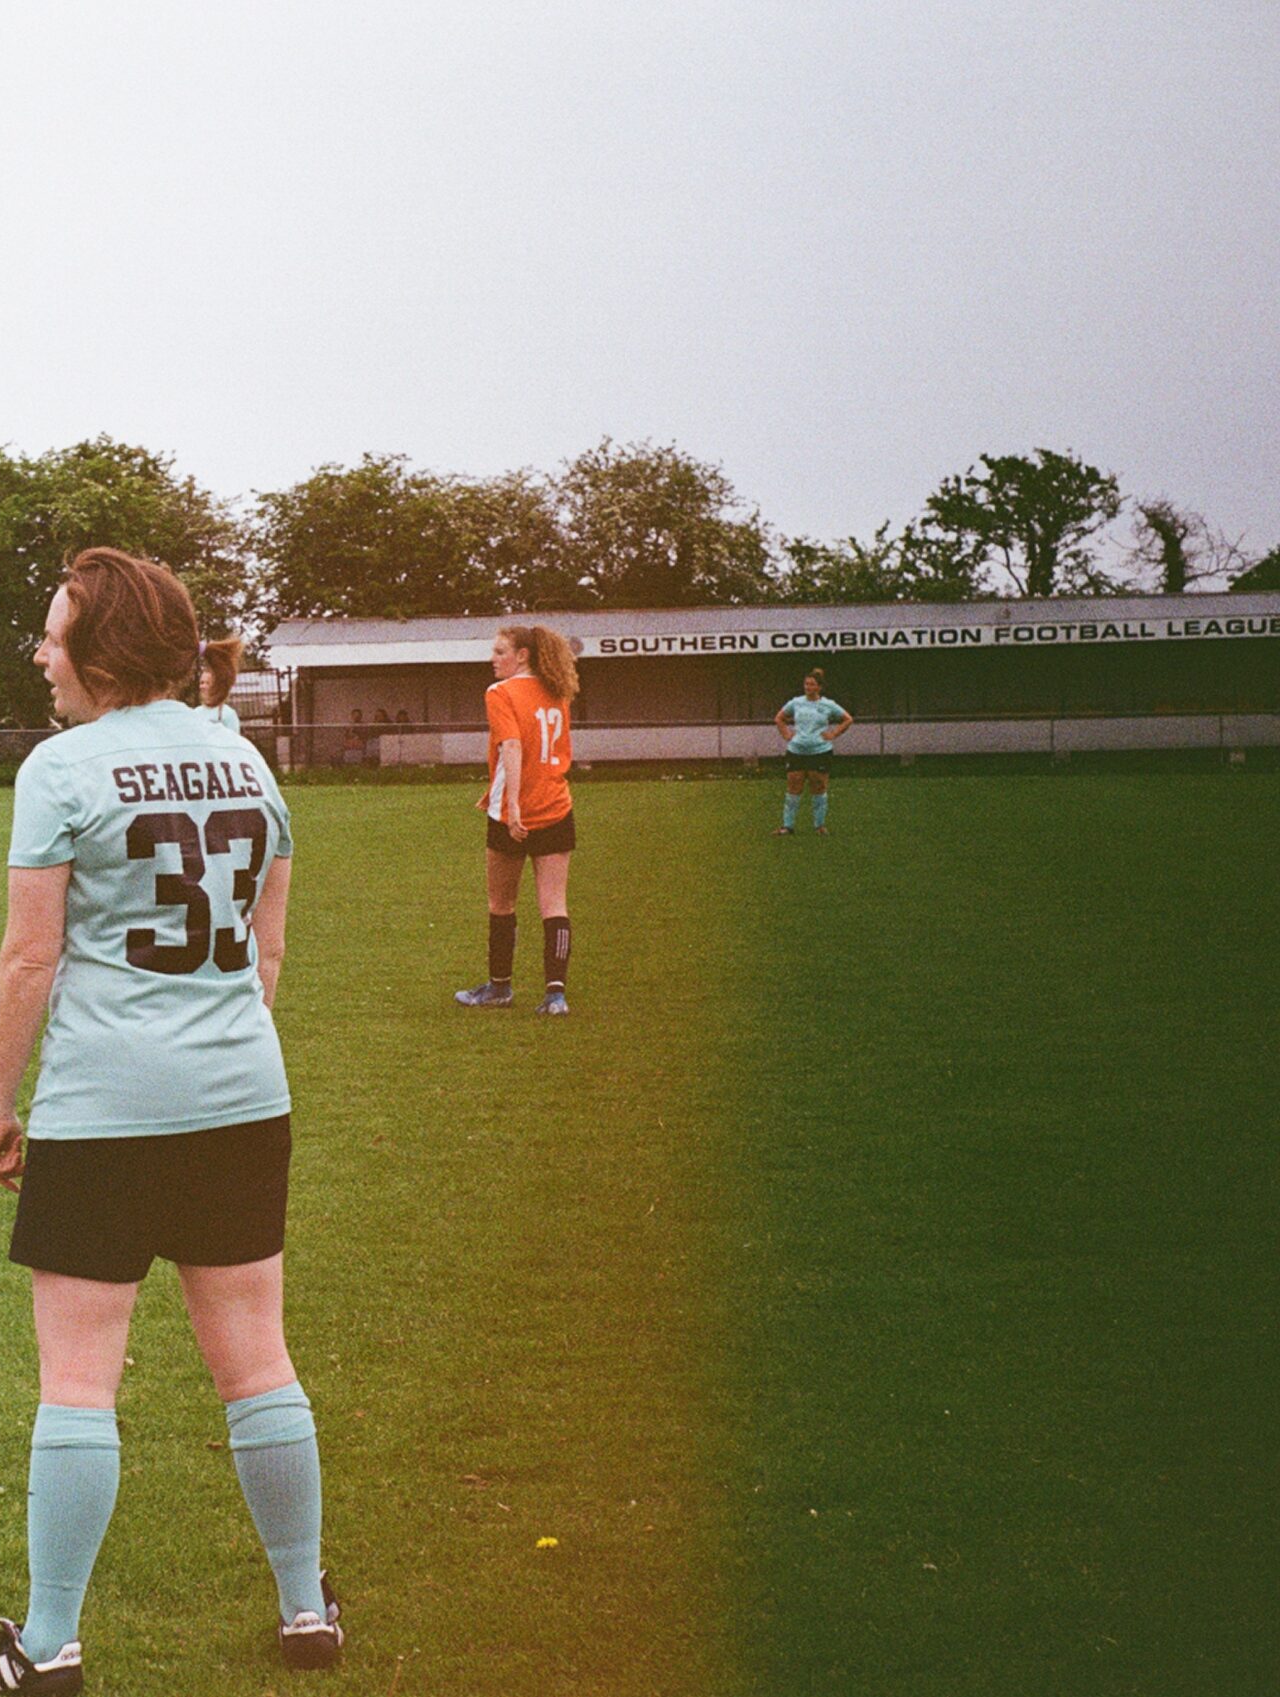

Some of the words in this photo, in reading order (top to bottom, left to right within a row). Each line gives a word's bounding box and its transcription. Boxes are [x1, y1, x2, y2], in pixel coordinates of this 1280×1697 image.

[600, 634, 759, 653] SOUTHERN
[770, 628, 982, 648] COMBINATION
[994, 622, 1156, 643] FOOTBALL
[534, 707, 563, 766] 12
[113, 762, 263, 803] SEAGALS
[125, 808, 267, 974] 33
